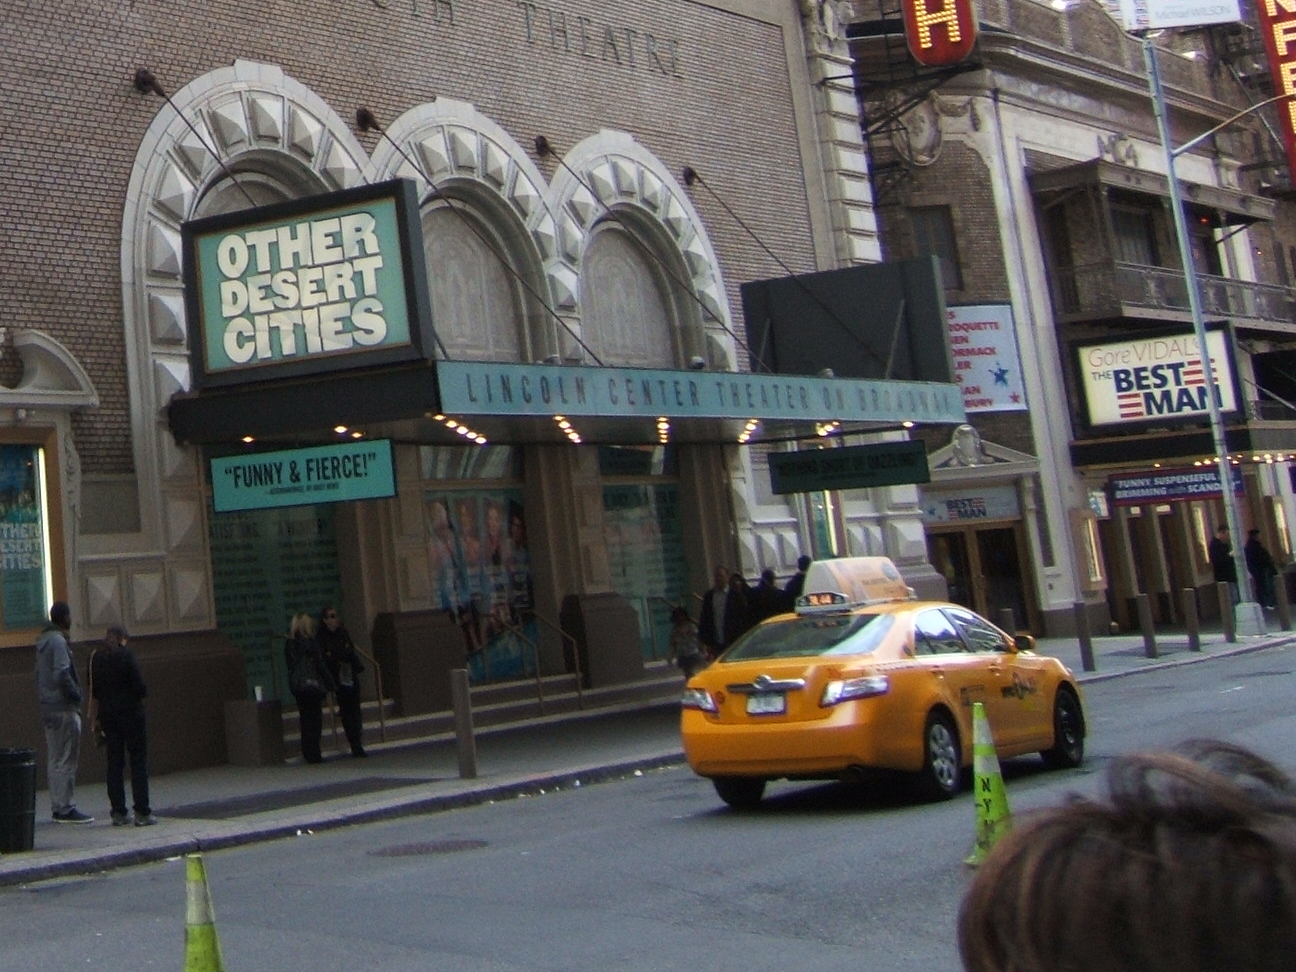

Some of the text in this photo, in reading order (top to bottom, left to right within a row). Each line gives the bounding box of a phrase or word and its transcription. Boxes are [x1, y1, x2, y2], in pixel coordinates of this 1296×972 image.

[516, 0, 684, 78] THEATRE
[217, 212, 379, 278] OTHER
[221, 256, 384, 319] DESERT
[223, 297, 389, 364] CITIES
[1089, 348, 1130, 368] Gore
[466, 372, 586, 404] LINCOLN
[608, 378, 700, 407] CENTER
[715, 381, 809, 410] THEATER
[822, 386, 844, 410] ON
[1092, 362, 1185, 393] THE BEST
[1143, 384, 1223, 415] MAN
[289, 460, 301, 484] &
[946, 498, 973, 509] BEST
[957, 508, 986, 519] MAN
